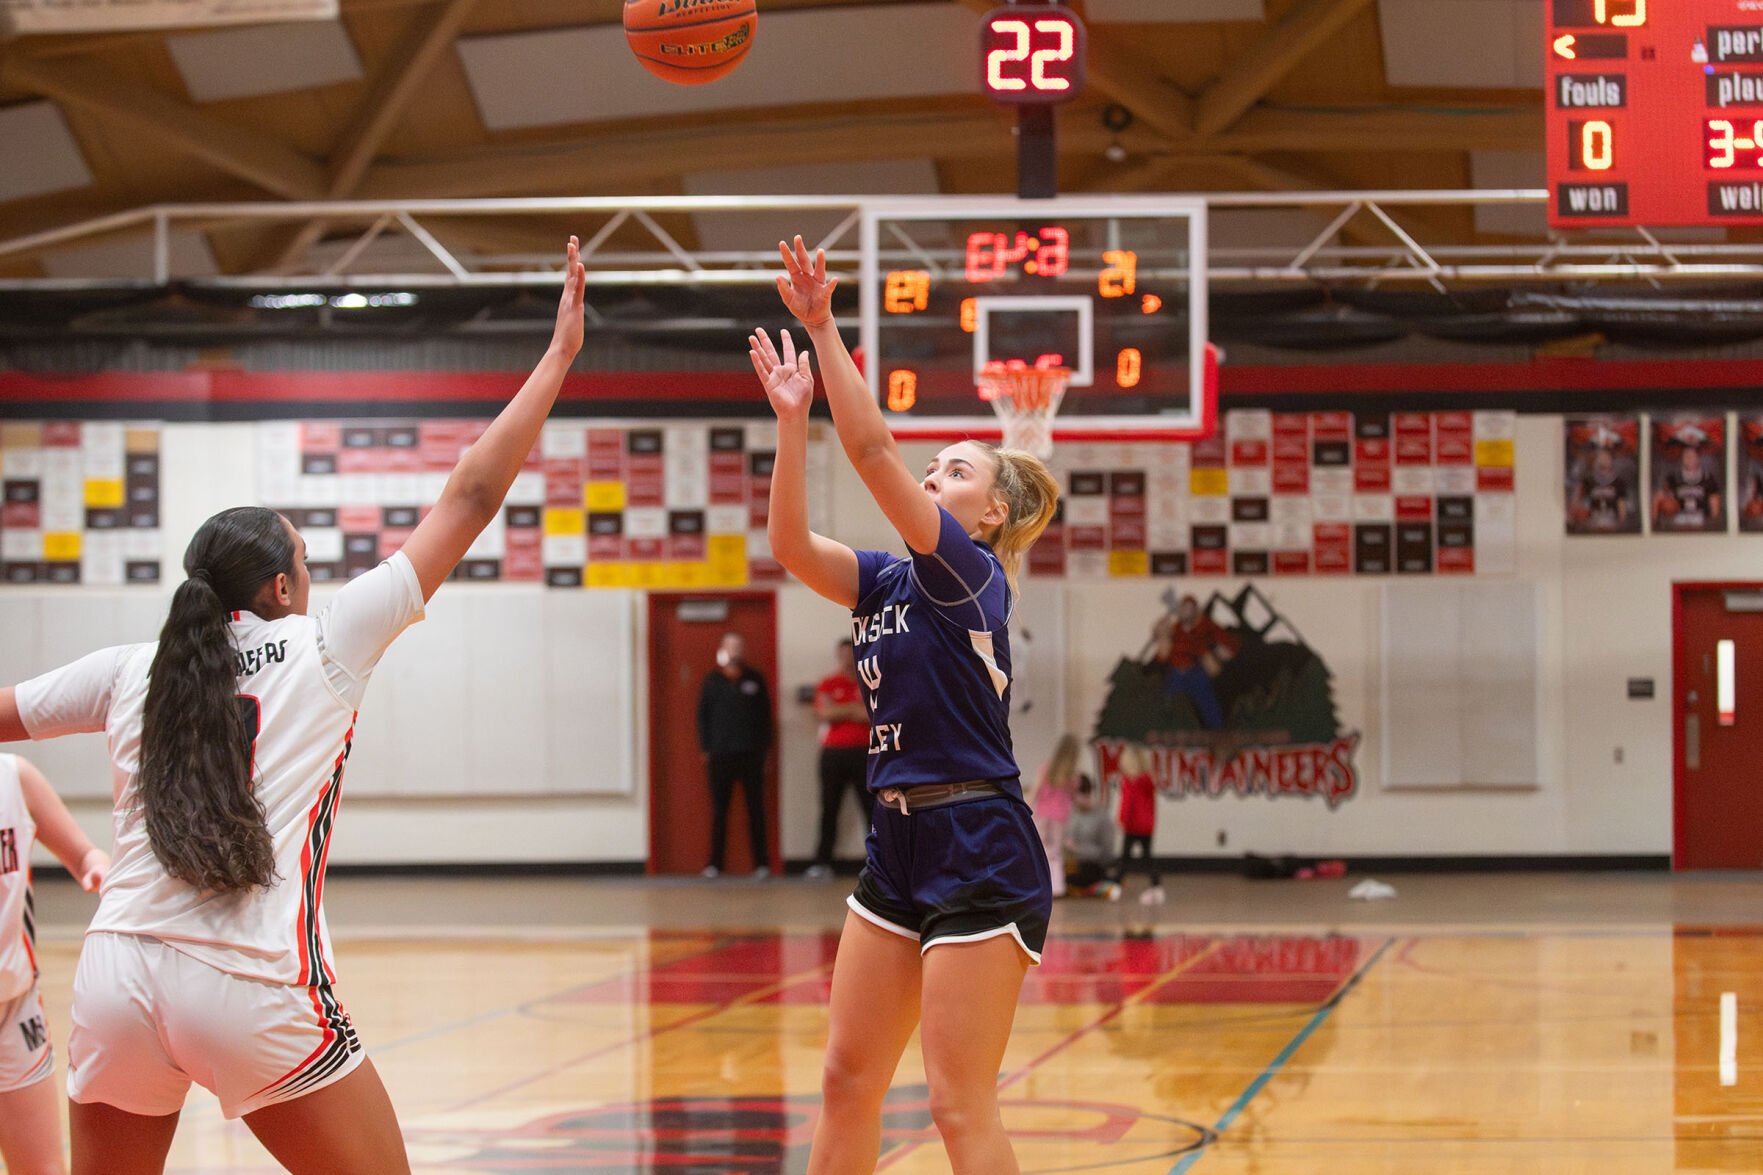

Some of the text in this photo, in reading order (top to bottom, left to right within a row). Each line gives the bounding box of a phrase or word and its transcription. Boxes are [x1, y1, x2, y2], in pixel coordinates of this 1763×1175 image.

[988, 20, 1073, 90] 22
[1717, 29, 1763, 61] per
[1561, 76, 1620, 106] fouls
[1582, 121, 1612, 170] 0
[1568, 187, 1618, 211] won
[1092, 732, 1359, 808] MUNTAINEERS
